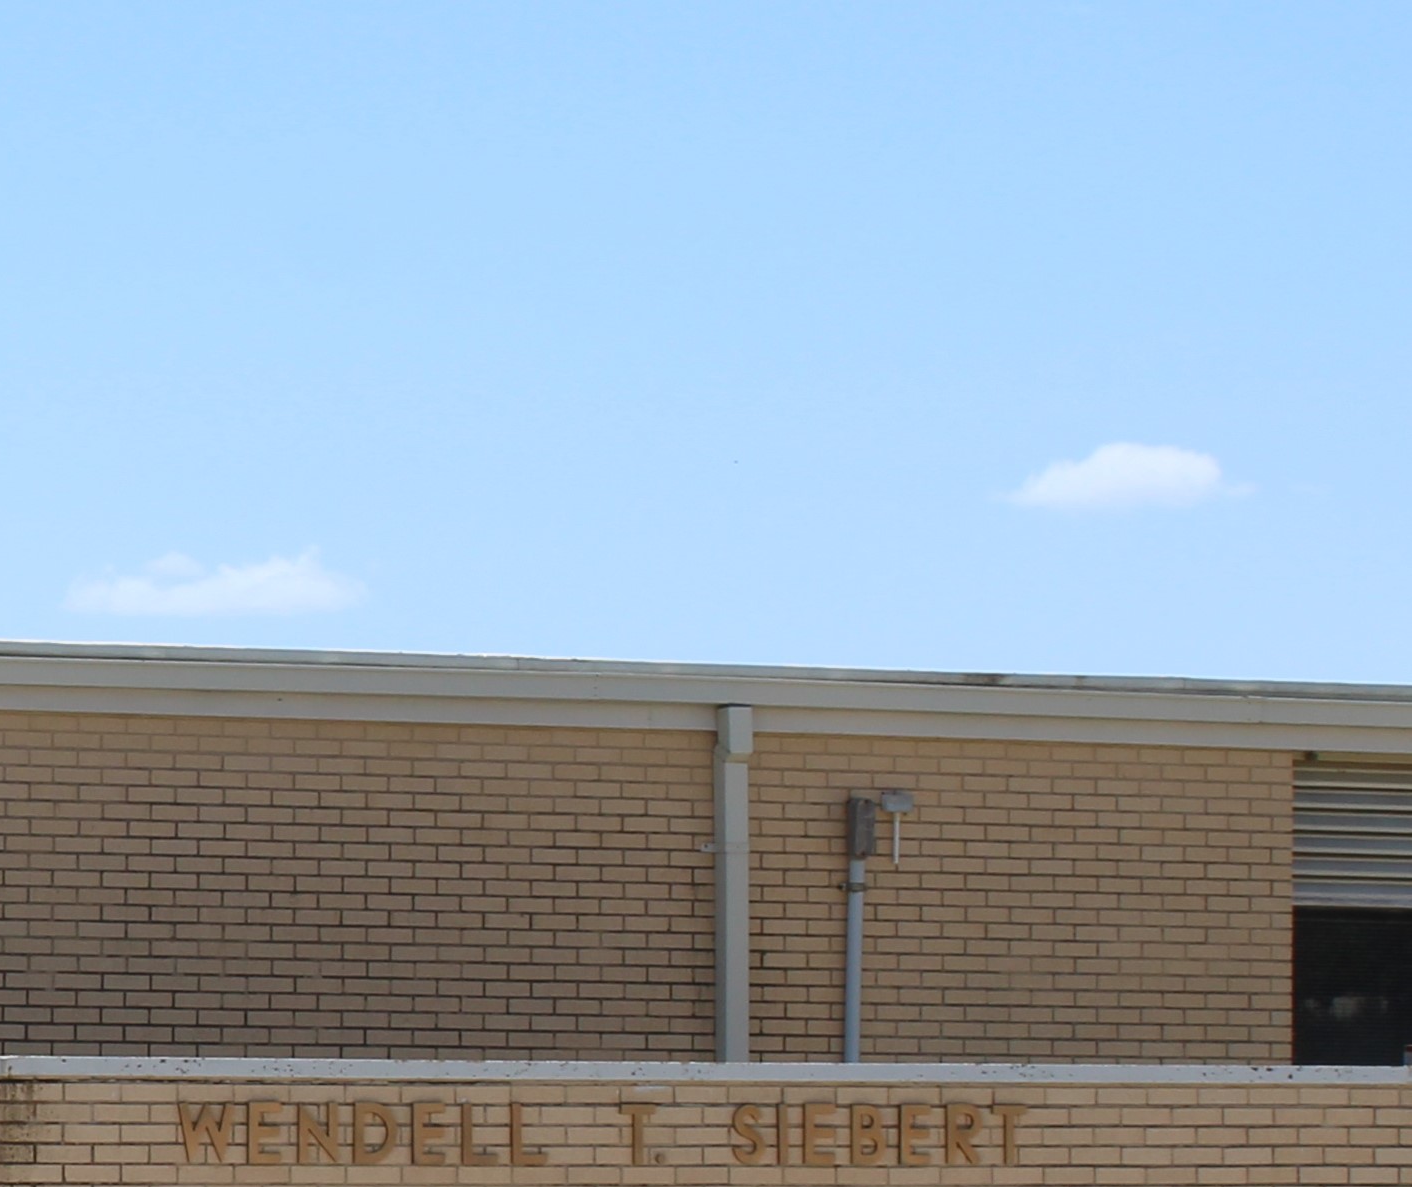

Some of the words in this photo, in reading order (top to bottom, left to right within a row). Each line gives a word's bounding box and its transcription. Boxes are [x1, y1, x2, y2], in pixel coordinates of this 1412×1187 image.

[175, 1099, 549, 1165] WENDELL
[618, 1100, 667, 1166] T.
[728, 1101, 1029, 1166] SIEBERT
